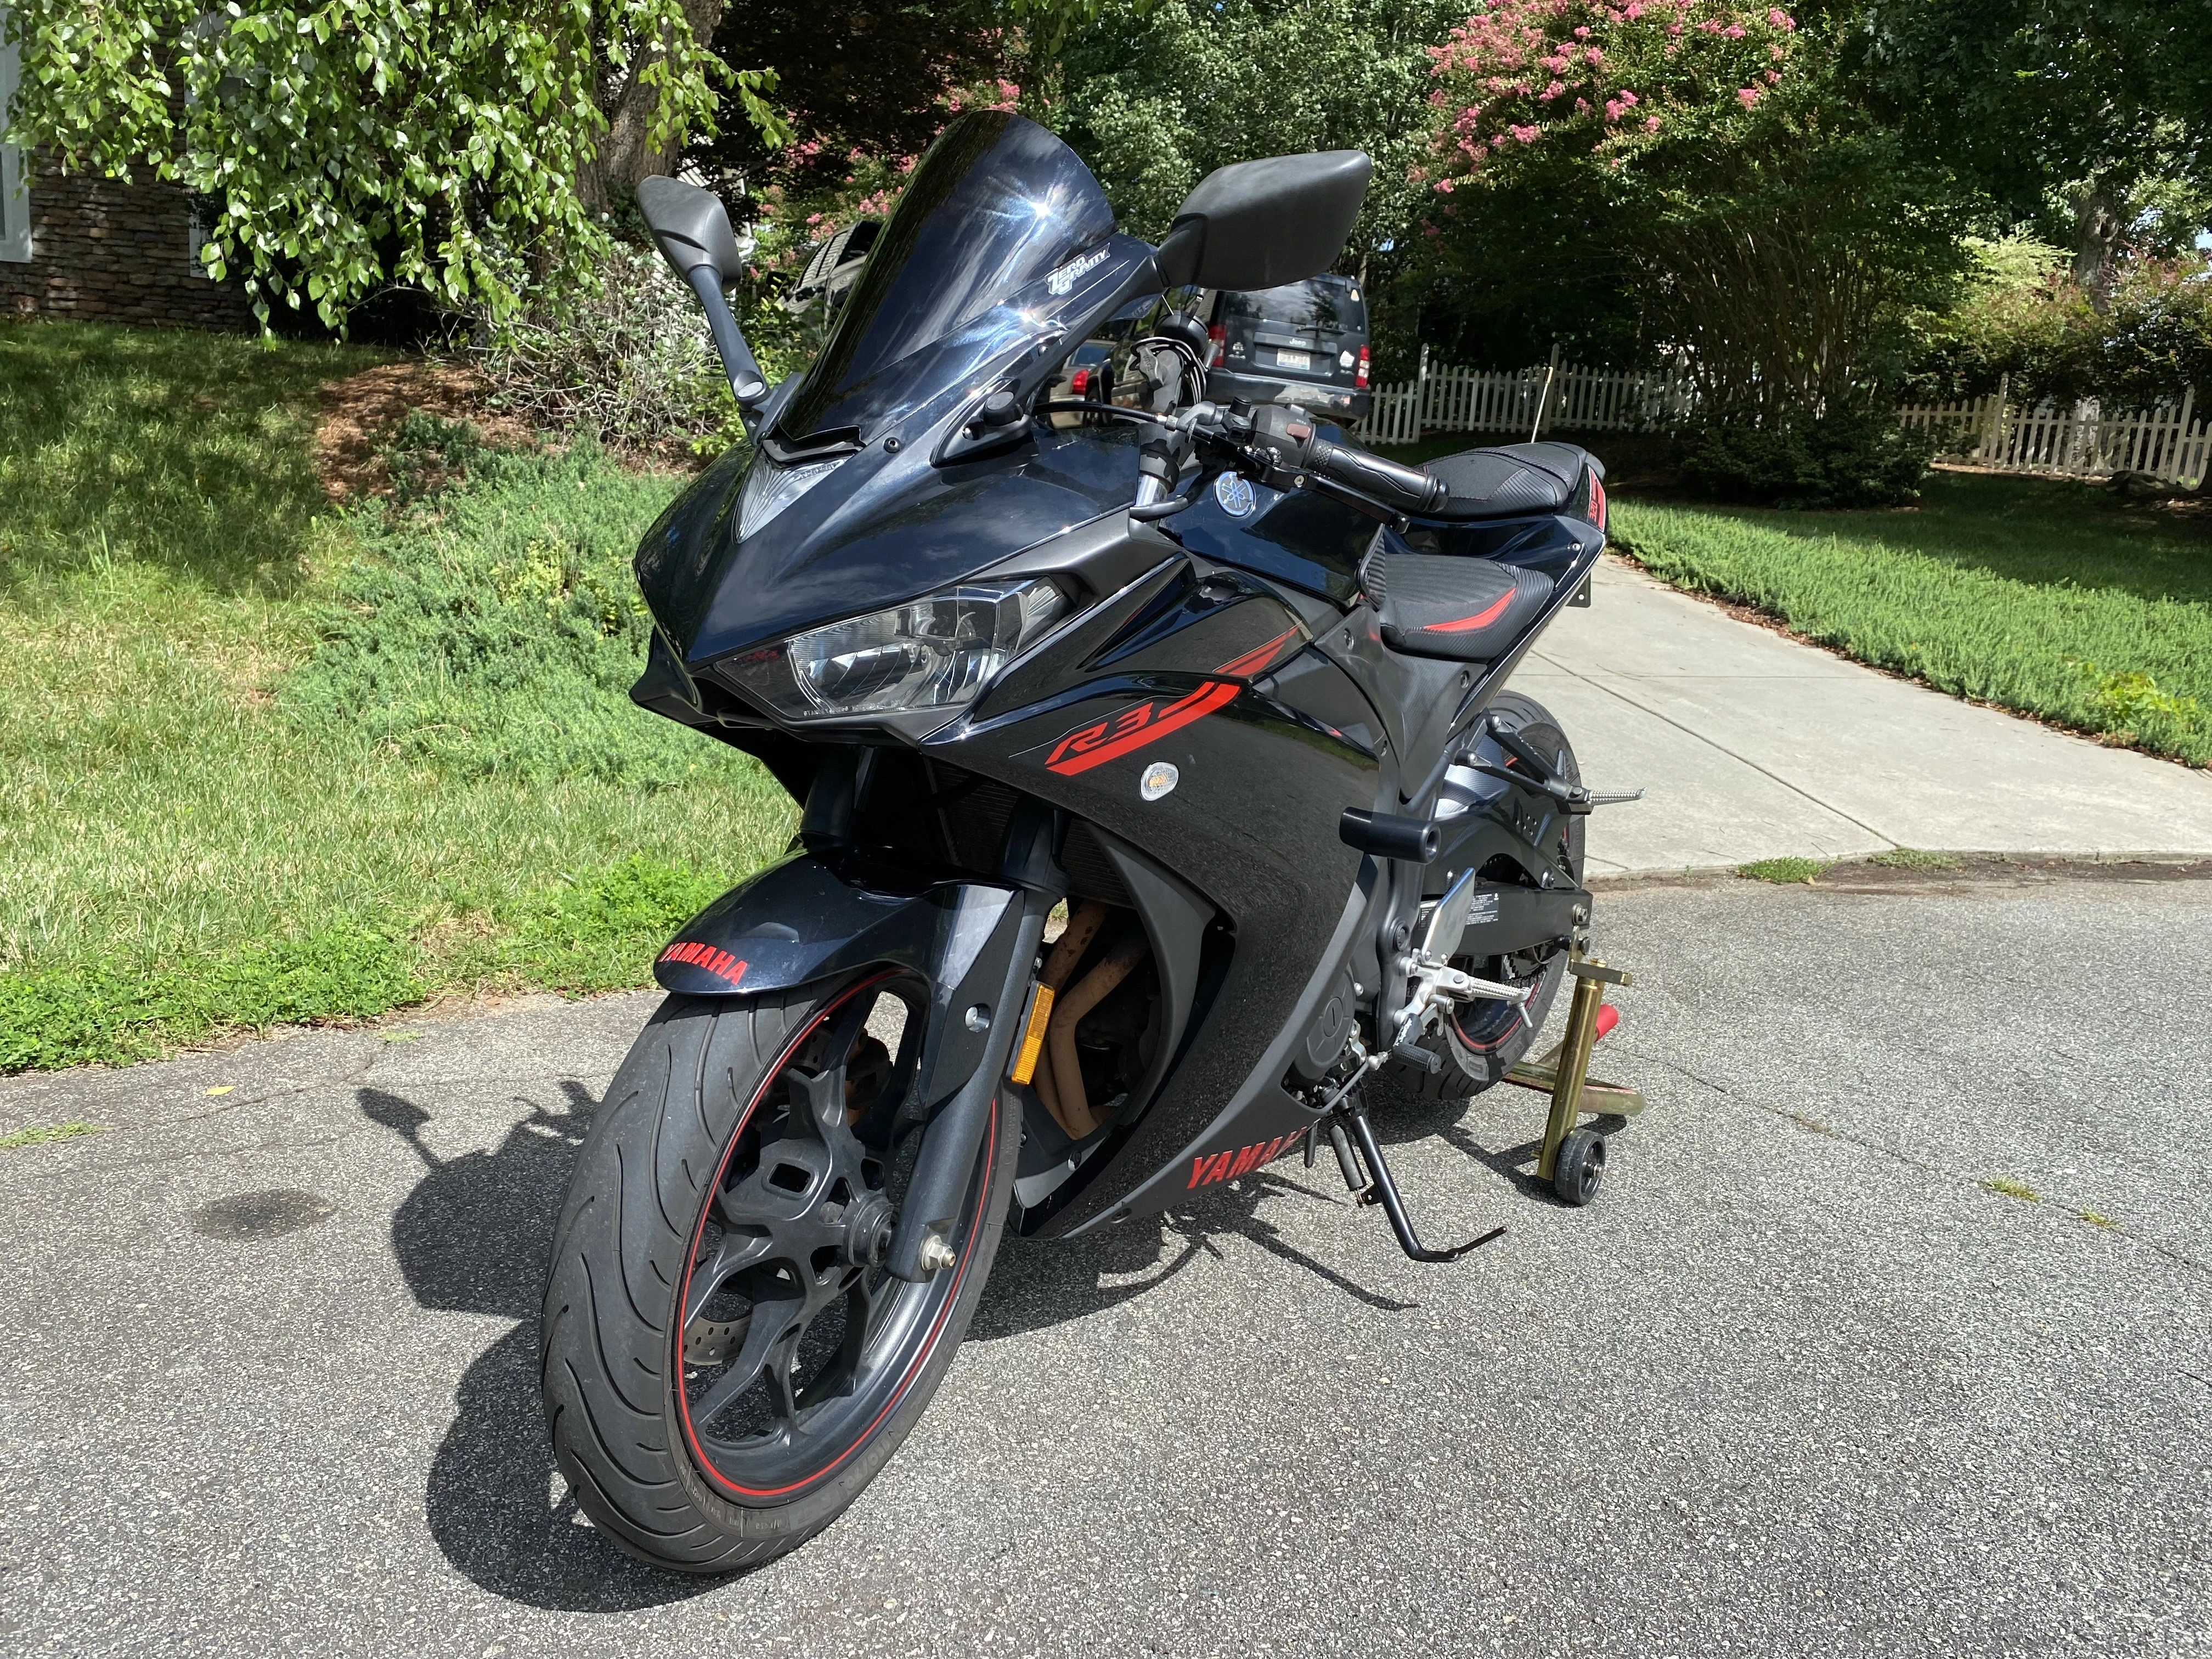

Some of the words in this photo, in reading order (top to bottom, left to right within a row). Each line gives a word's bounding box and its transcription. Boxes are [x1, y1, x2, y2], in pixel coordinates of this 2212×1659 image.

[1047, 256, 1086, 292] ZERO
[1059, 250, 1106, 293] GRAVITY
[1289, 338, 1306, 347] Jeep
[1045, 702, 1154, 765] R3
[659, 942, 748, 985] YAMAHA
